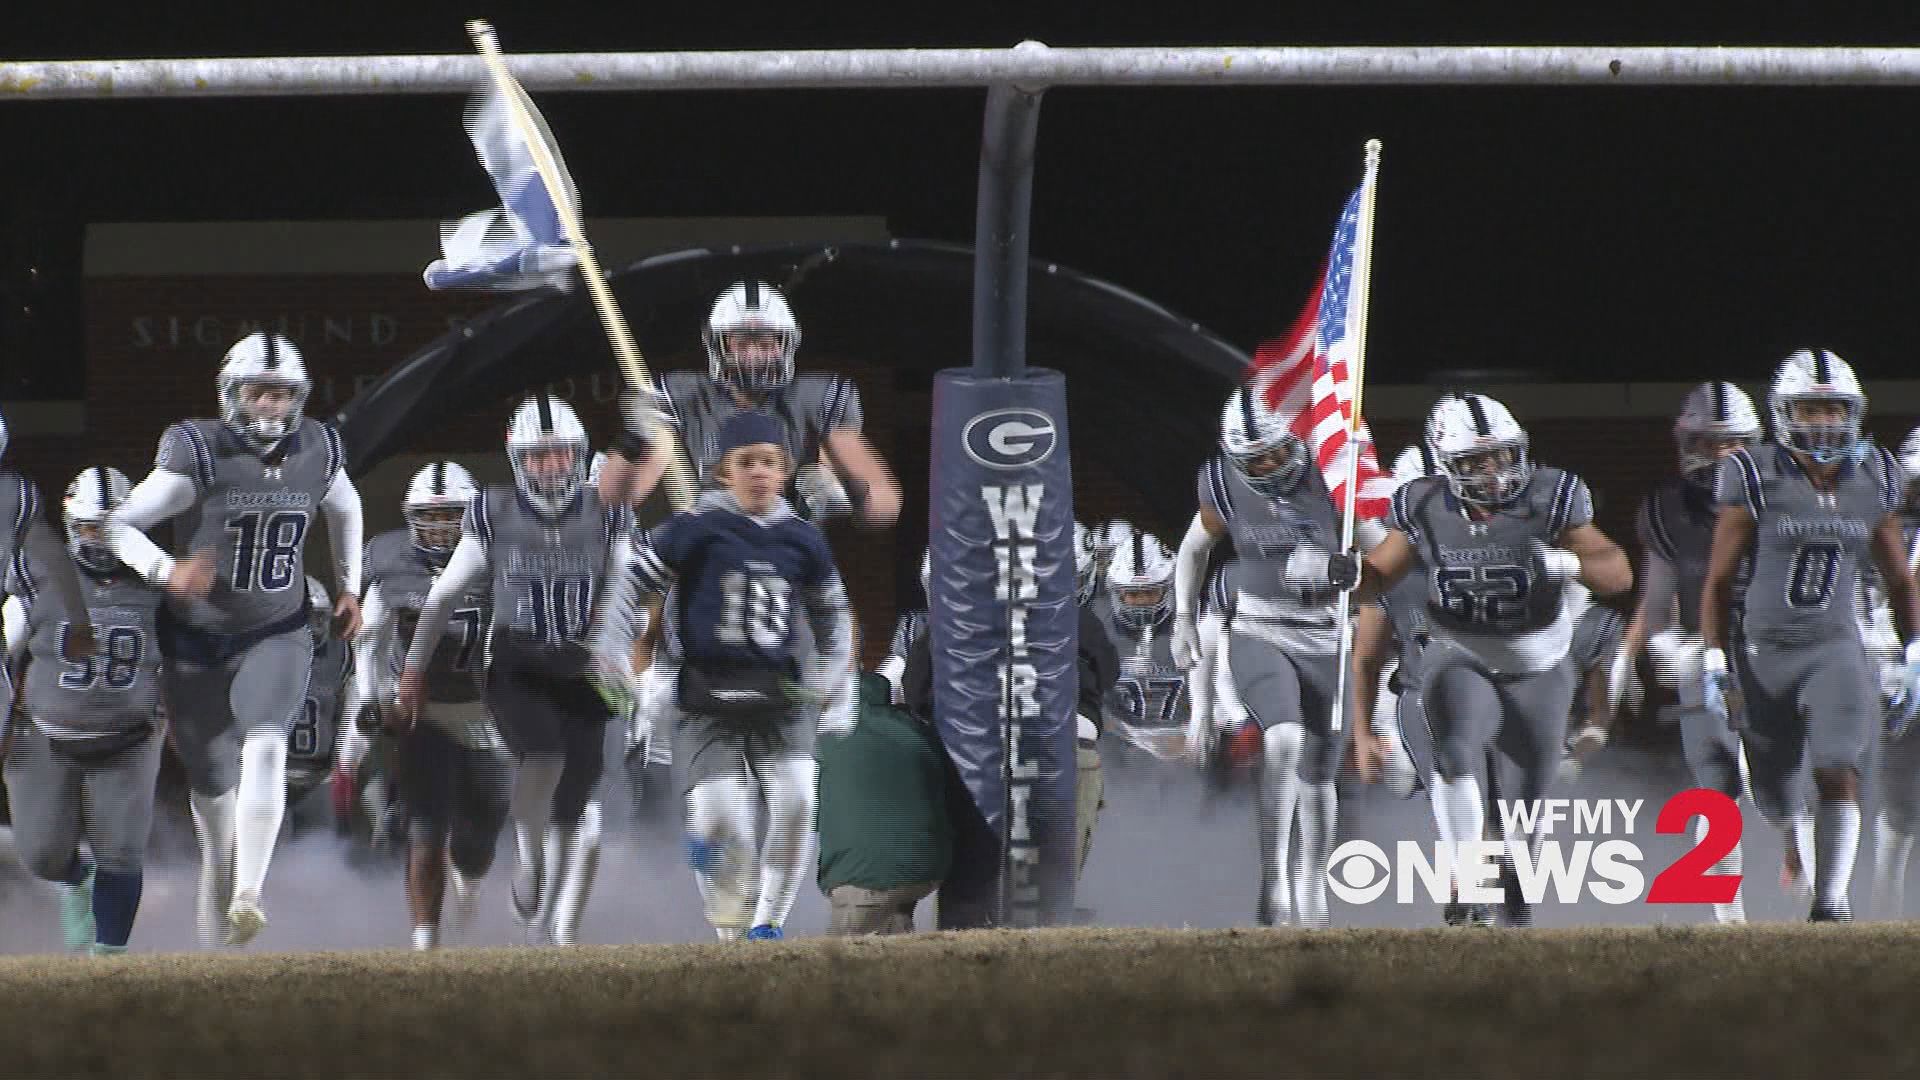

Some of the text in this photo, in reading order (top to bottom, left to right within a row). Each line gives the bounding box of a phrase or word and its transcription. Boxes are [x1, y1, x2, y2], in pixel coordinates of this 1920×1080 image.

[224, 510, 309, 592] 18
[1784, 538, 1843, 610] 0
[1434, 564, 1532, 626] 62
[56, 621, 147, 690] 58
